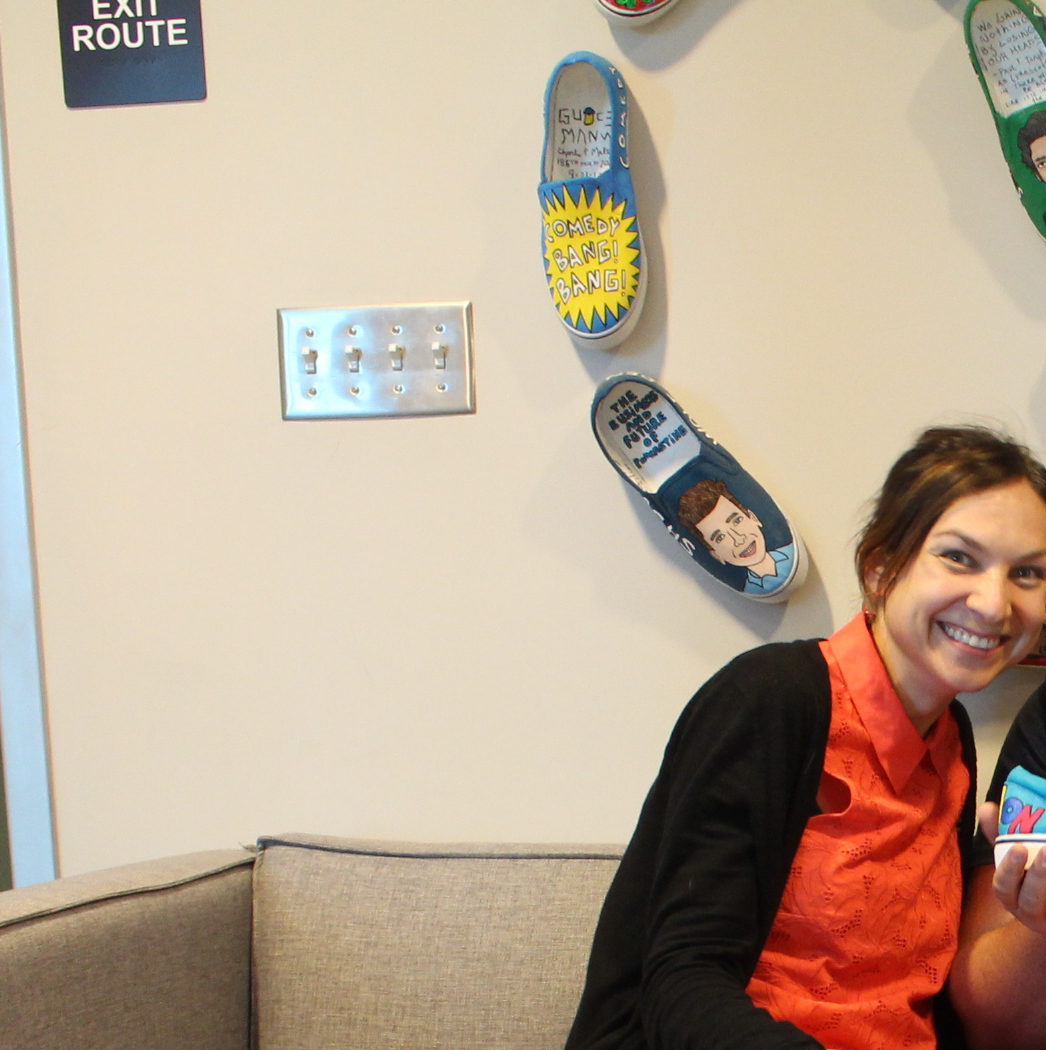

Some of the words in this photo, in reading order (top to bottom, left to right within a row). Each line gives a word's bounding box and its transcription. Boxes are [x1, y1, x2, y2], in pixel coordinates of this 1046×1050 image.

[91, 0, 158, 20] EXIT
[71, 18, 189, 52] ROUTE
[545, 213, 621, 243] COMEDY
[552, 238, 619, 273] BANG!
[556, 268, 627, 305] BANG!
[609, 389, 638, 414] THE
[622, 410, 667, 450] FUTURE
[626, 409, 652, 433] AND
[643, 430, 660, 447] OF
[1000, 784, 1045, 835] ON
